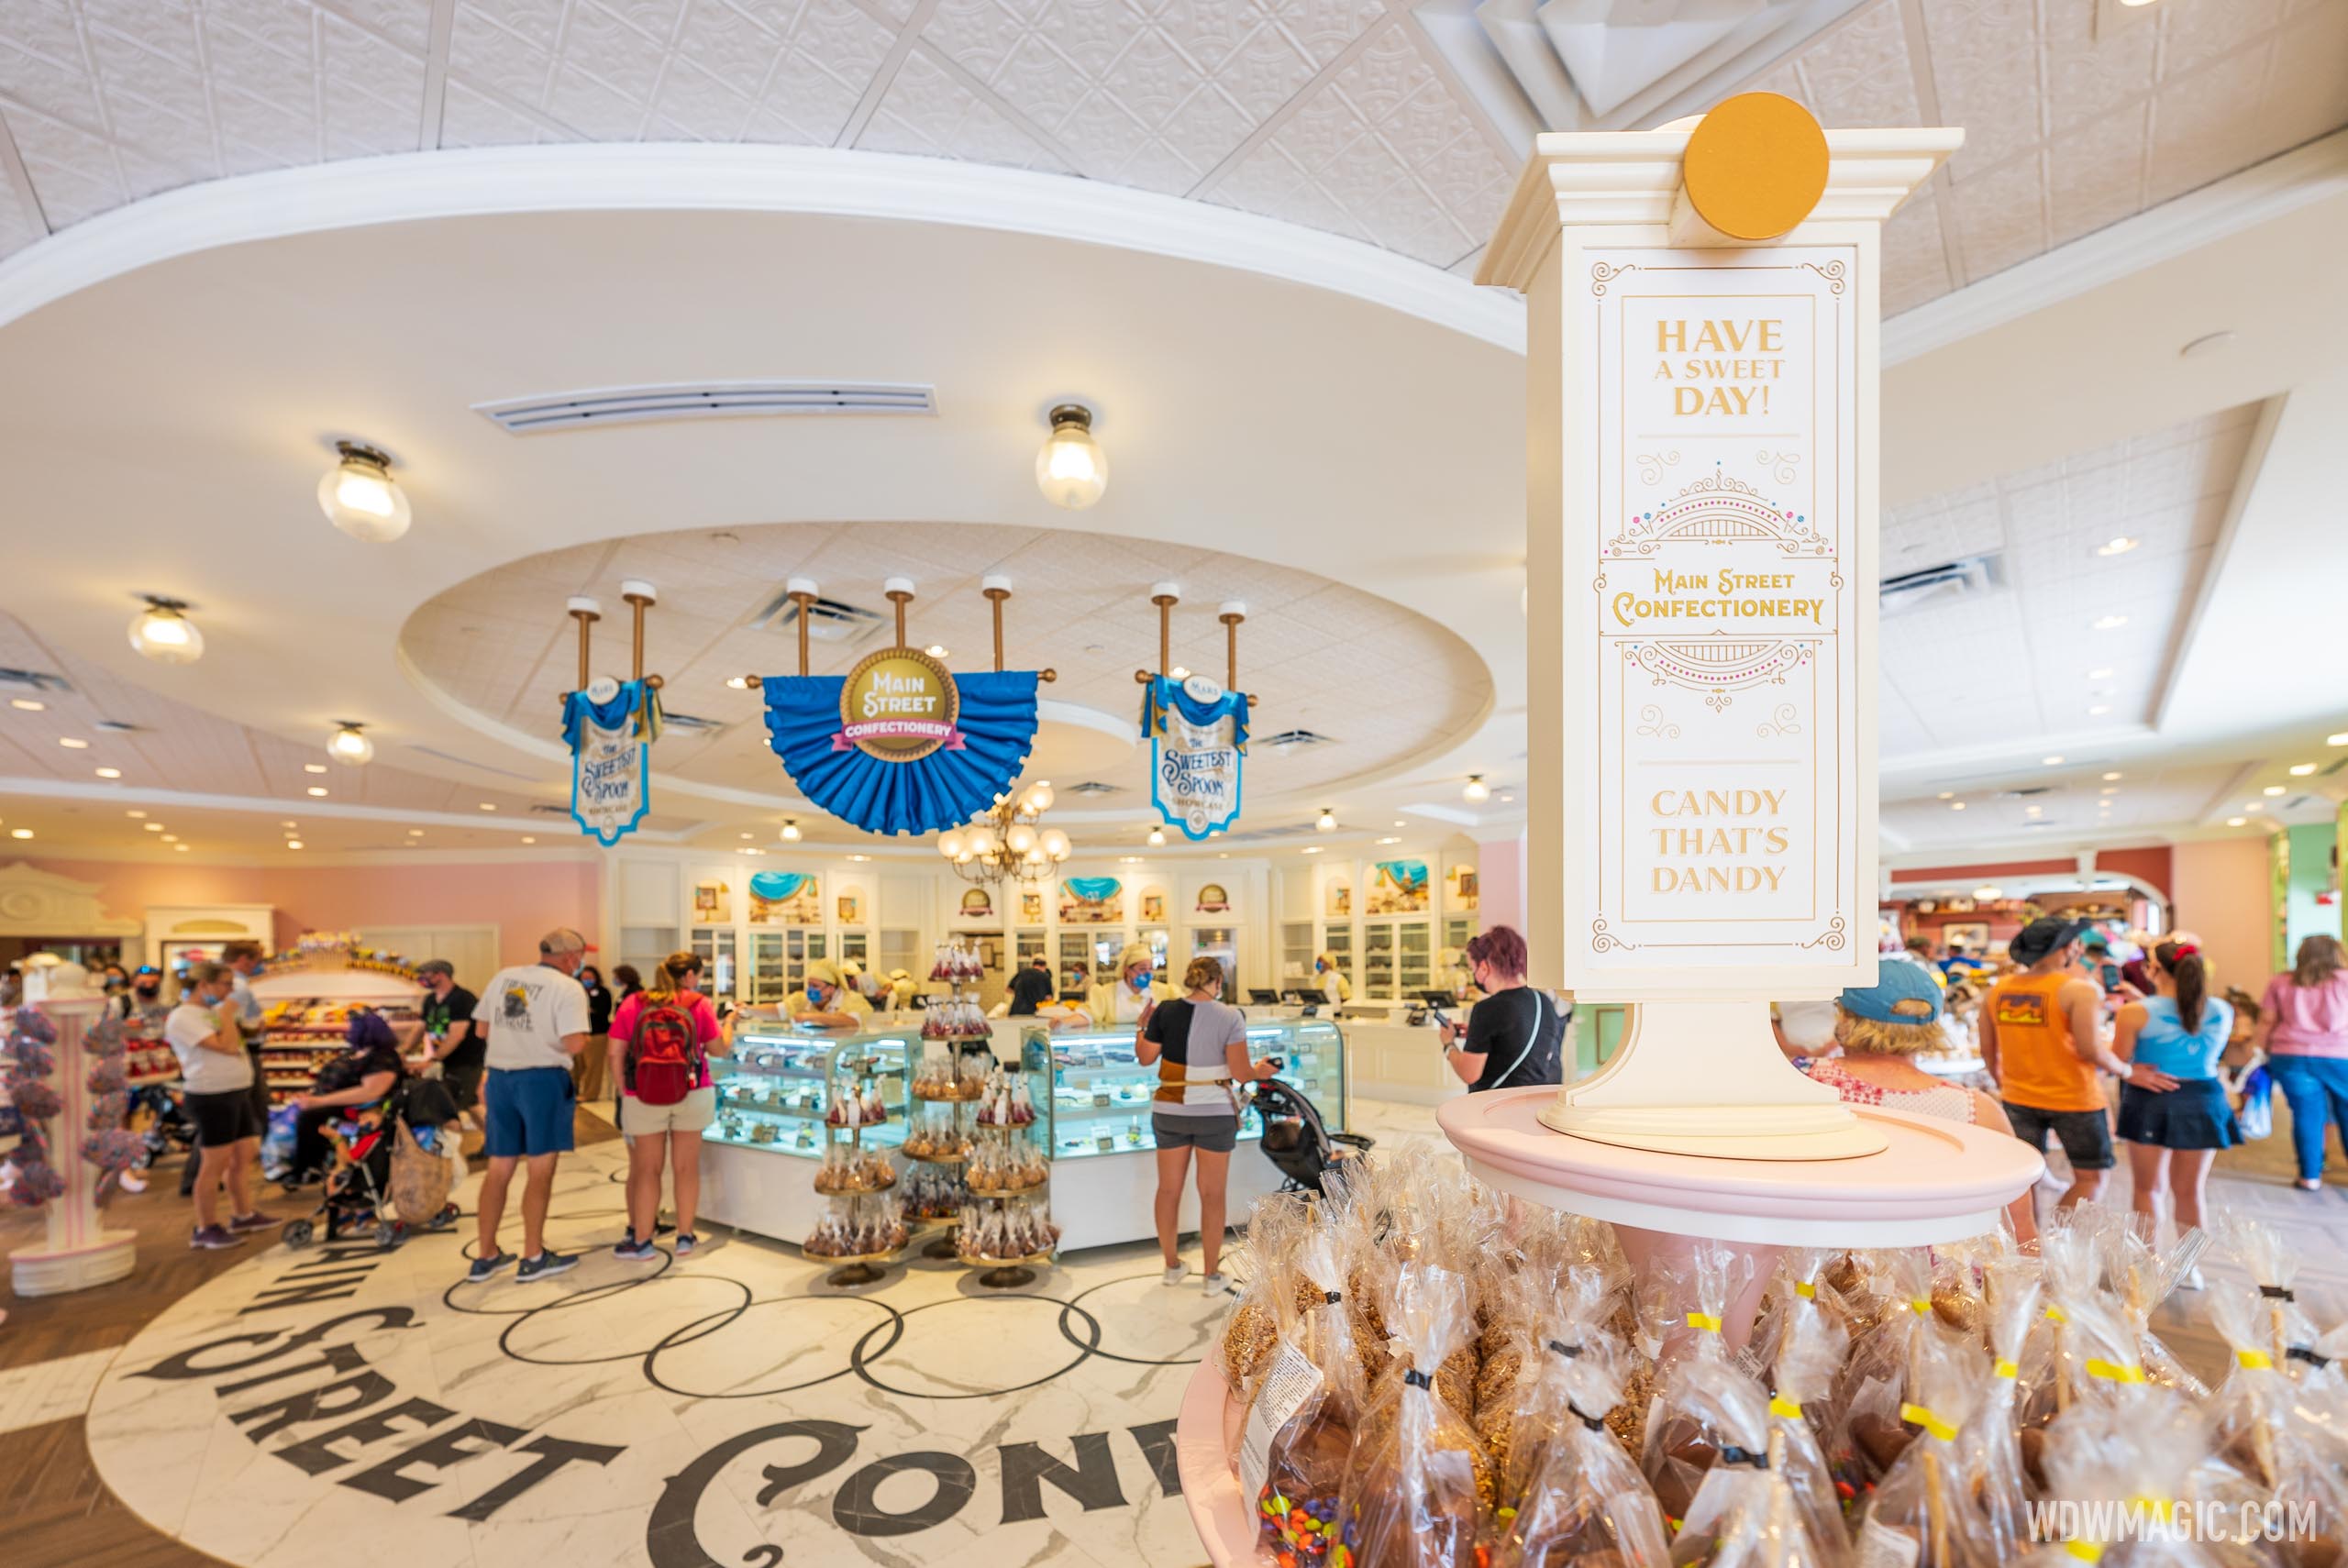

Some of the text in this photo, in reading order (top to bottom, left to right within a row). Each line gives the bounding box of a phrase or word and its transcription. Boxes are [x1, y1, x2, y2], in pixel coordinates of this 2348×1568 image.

[1656, 320, 1784, 352] HAVE
[1654, 359, 1786, 380] A SWEET
[1673, 385, 1770, 416] DAY!
[1654, 569, 1795, 596] MAIN STREET
[1612, 591, 1824, 627] CONFECTIONERY
[872, 671, 925, 694] MAIN
[862, 690, 936, 718] STREET
[845, 721, 952, 738] CONFECTIONERY
[1161, 748, 1232, 787] SWEETEST
[1651, 789, 1788, 816] CANDY
[1651, 826, 1789, 856] THAT'S
[1651, 866, 1788, 894] DANDY
[119, 1305, 629, 1522] STREET
